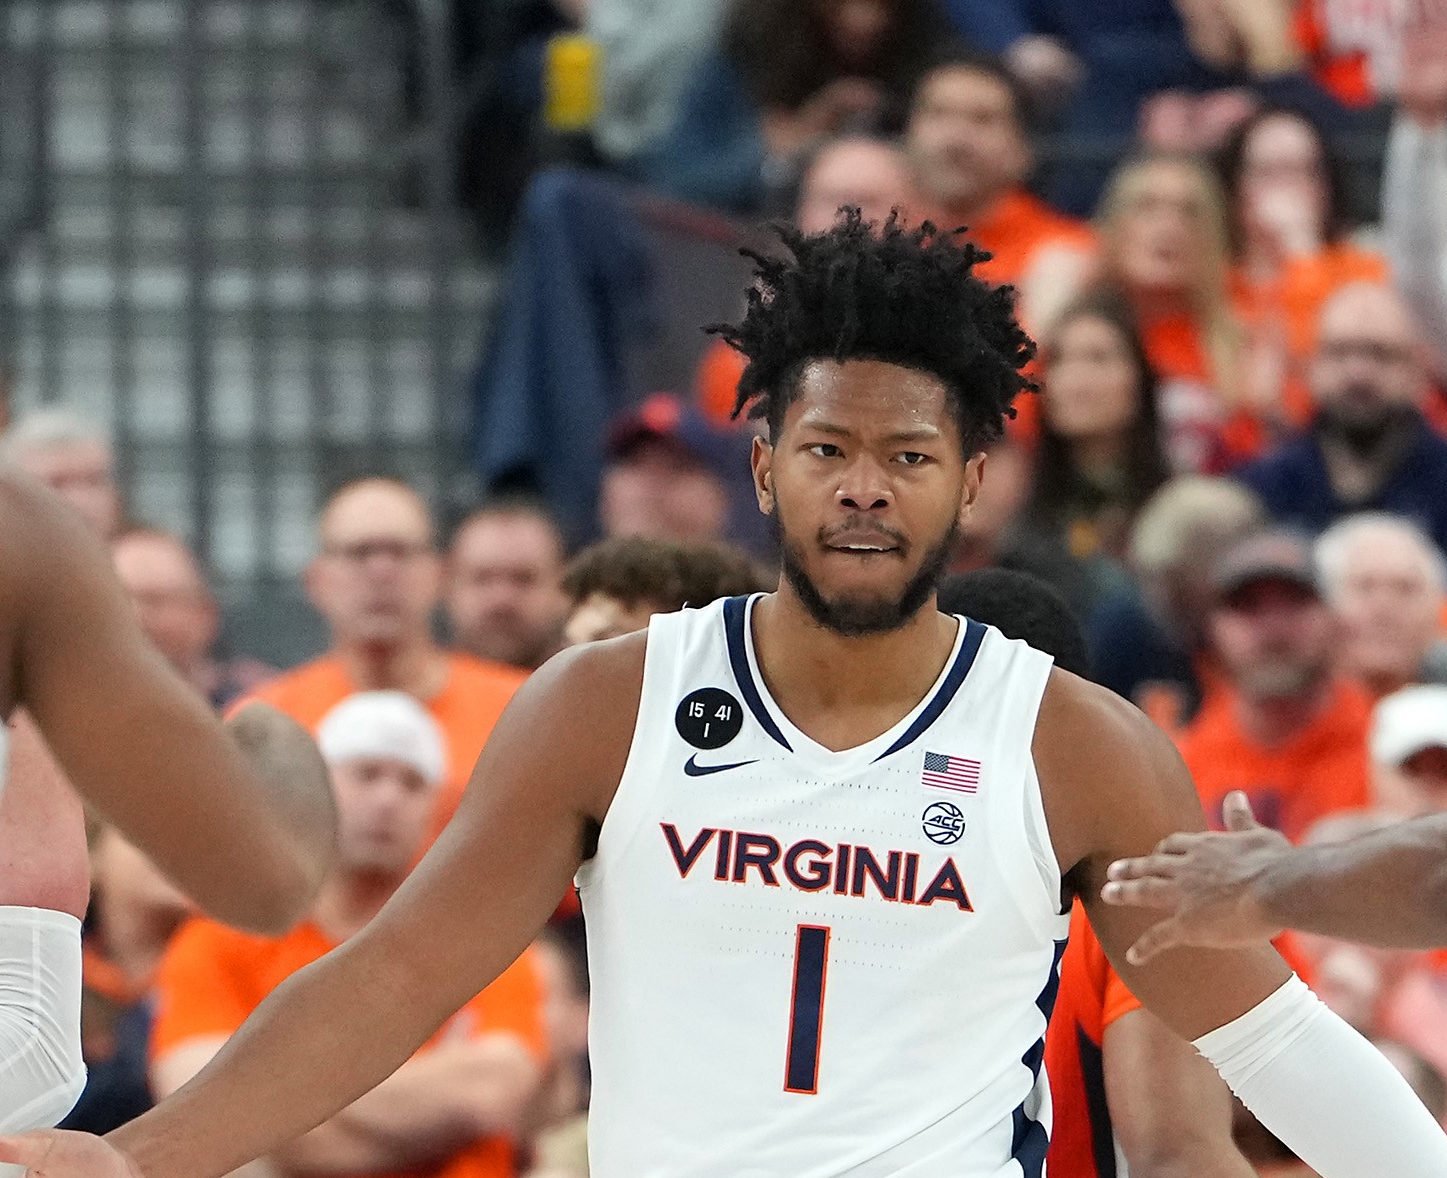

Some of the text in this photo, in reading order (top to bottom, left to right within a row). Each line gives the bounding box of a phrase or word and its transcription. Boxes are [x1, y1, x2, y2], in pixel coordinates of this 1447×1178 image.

[688, 701, 732, 722] 15 41
[659, 822, 975, 913] VIRGINIA
[783, 923, 831, 1095] 1
